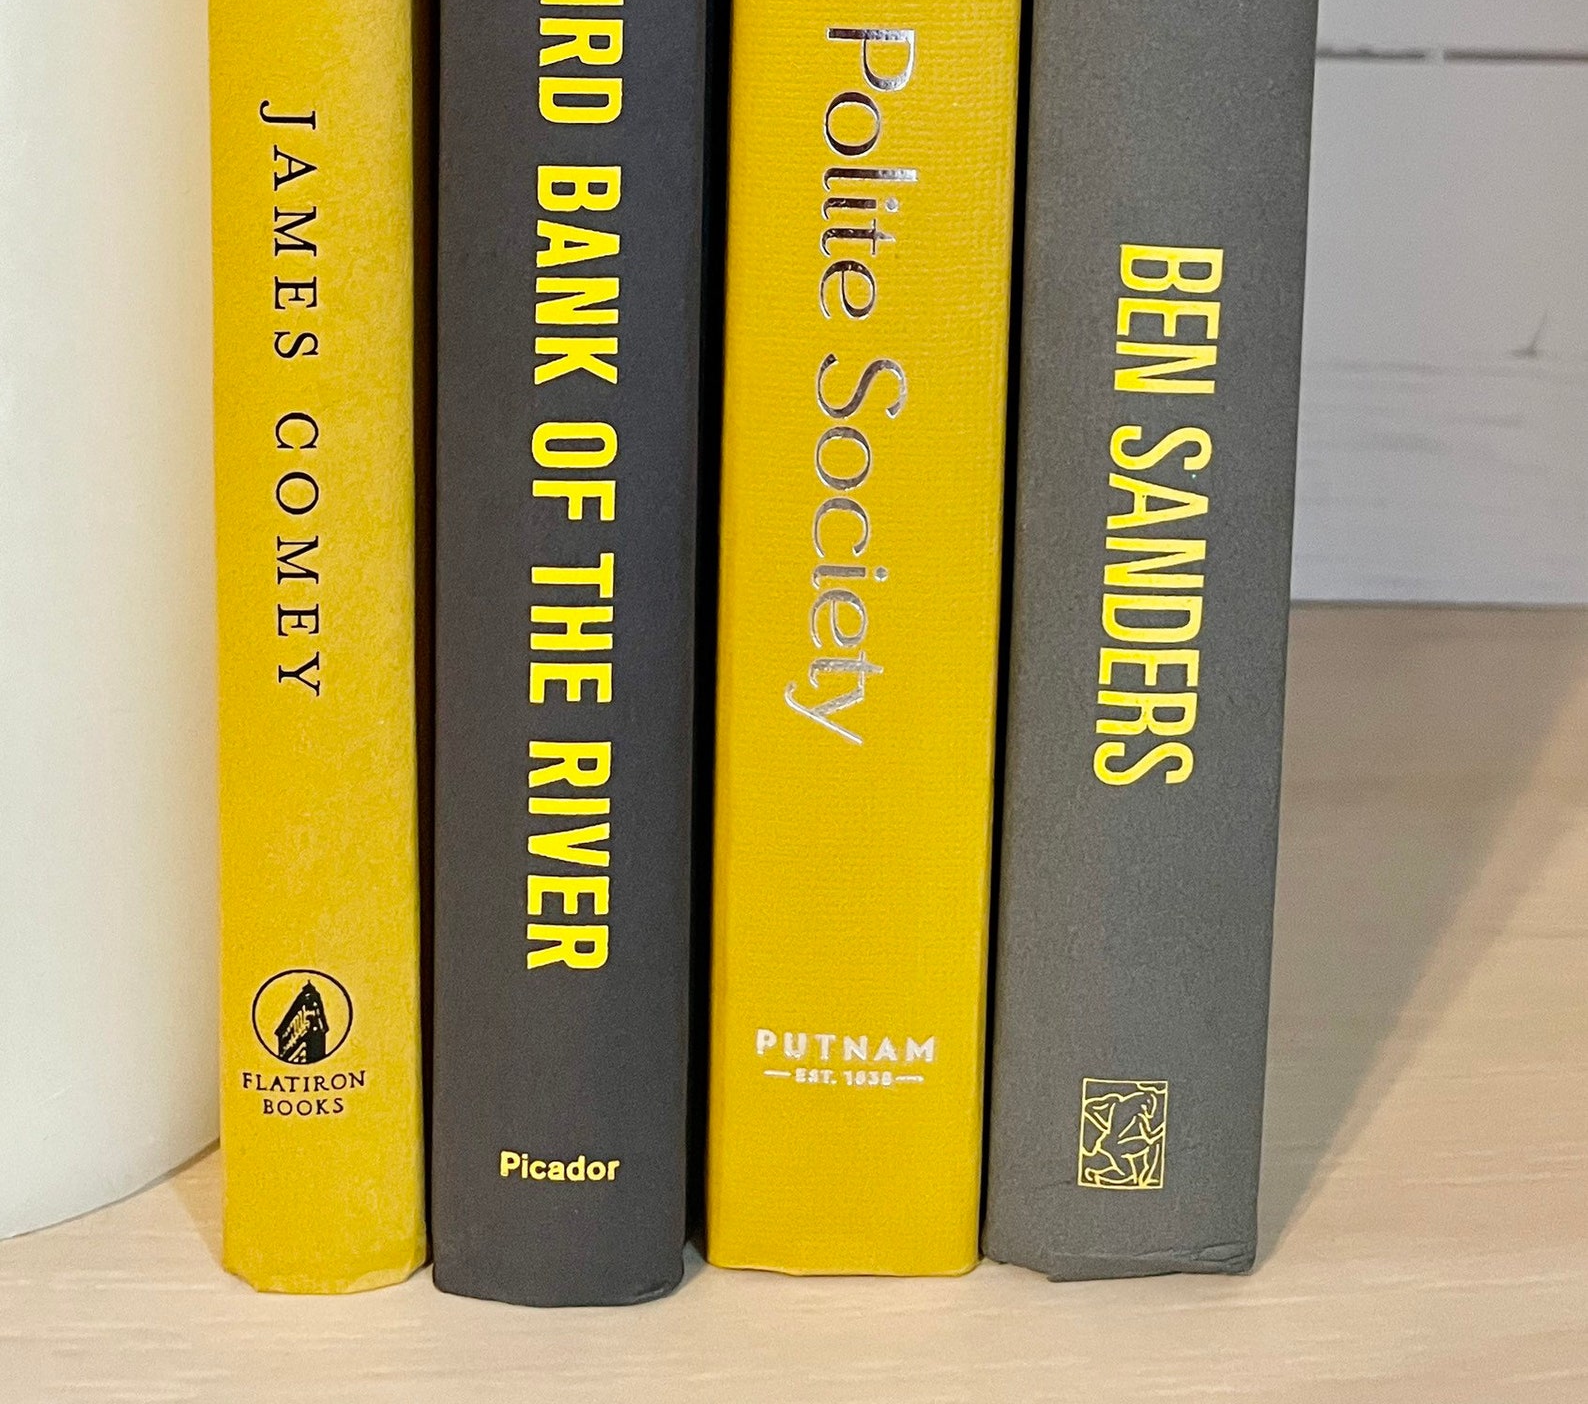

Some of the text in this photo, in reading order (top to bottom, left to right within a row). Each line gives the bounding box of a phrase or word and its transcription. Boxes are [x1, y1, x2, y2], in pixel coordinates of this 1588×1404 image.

[533, 164, 622, 386] BANK
[258, 98, 322, 697] JAMES COMEY
[782, 24, 921, 747] Polite Society
[531, 420, 619, 523] OF
[1091, 242, 1225, 787] BEN SANDERS
[528, 551, 616, 705] THE
[525, 739, 613, 971] RIVER
[241, 1069, 367, 1094] FLATIRON
[262, 1097, 345, 1117] BOOKS
[754, 1027, 937, 1064] PUTNAM
[794, 1066, 838, 1085] EST.
[498, 1150, 621, 1183] Picador
